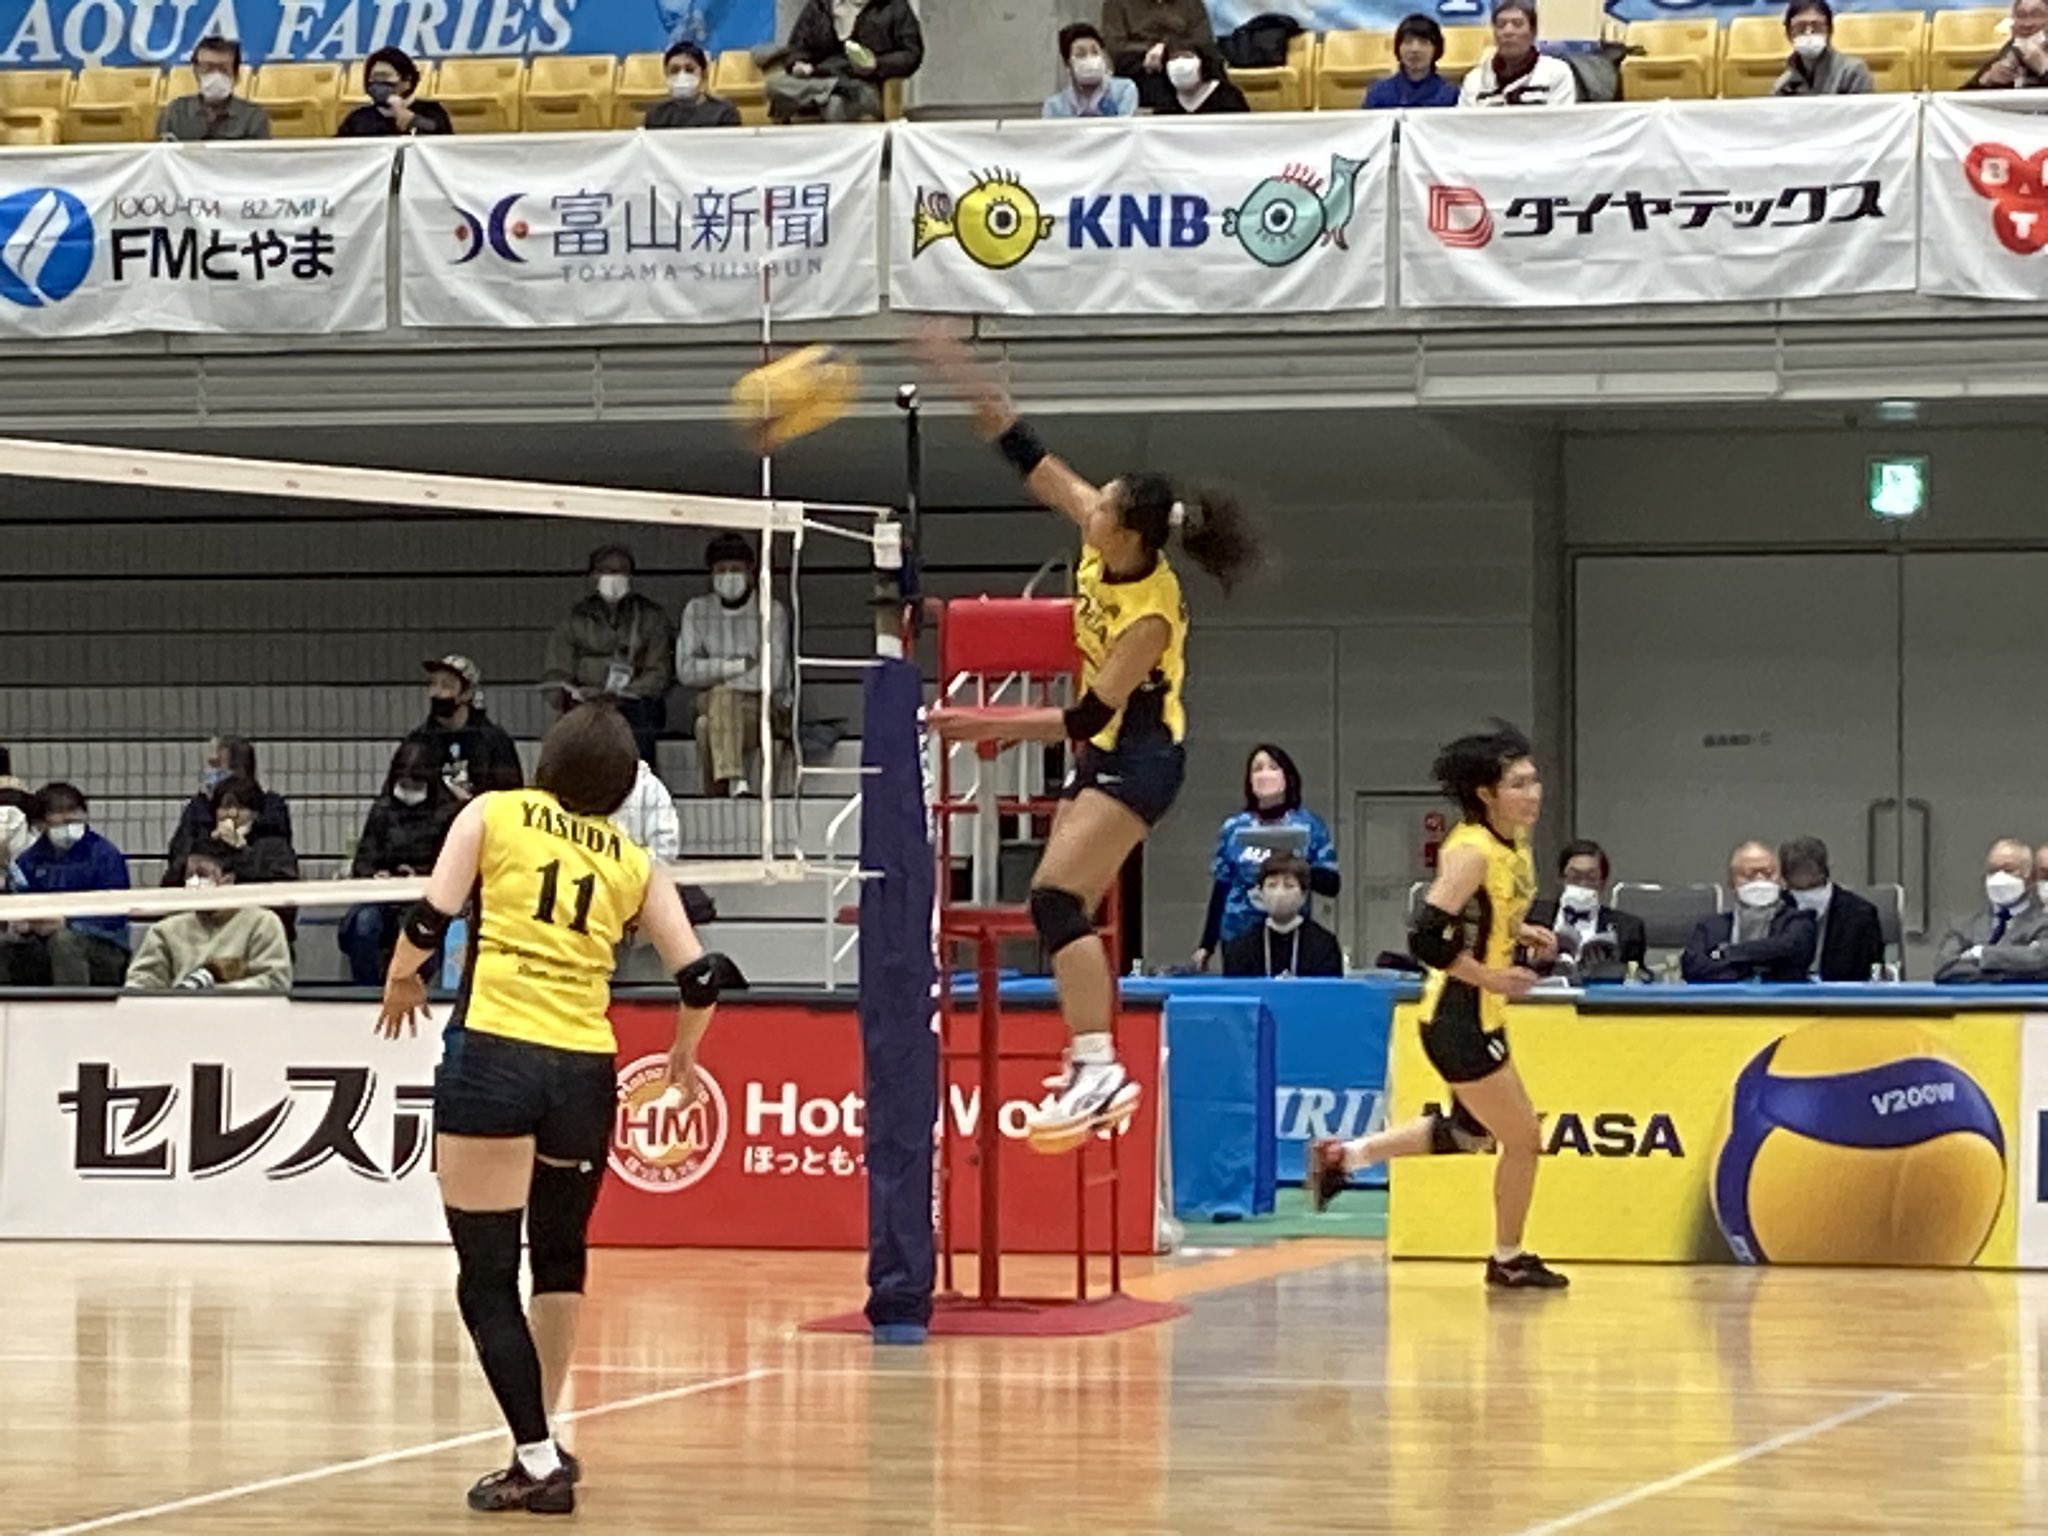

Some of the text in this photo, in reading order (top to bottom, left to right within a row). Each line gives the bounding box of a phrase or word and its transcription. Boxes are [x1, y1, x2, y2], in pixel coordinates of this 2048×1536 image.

[0, 0, 576, 70] AQUA FAIRIES
[552, 183, 831, 257] 富山新聞
[1068, 193, 1210, 249] KNB
[1502, 180, 1886, 237] ダイヤテックス
[111, 227, 335, 281] FMとやま
[561, 263, 677, 284] TOYAMA
[521, 800, 622, 862] YASUDA
[531, 858, 596, 936] 11
[745, 1081, 866, 1137] Hot
[743, 1144, 868, 1176] ほっとも
